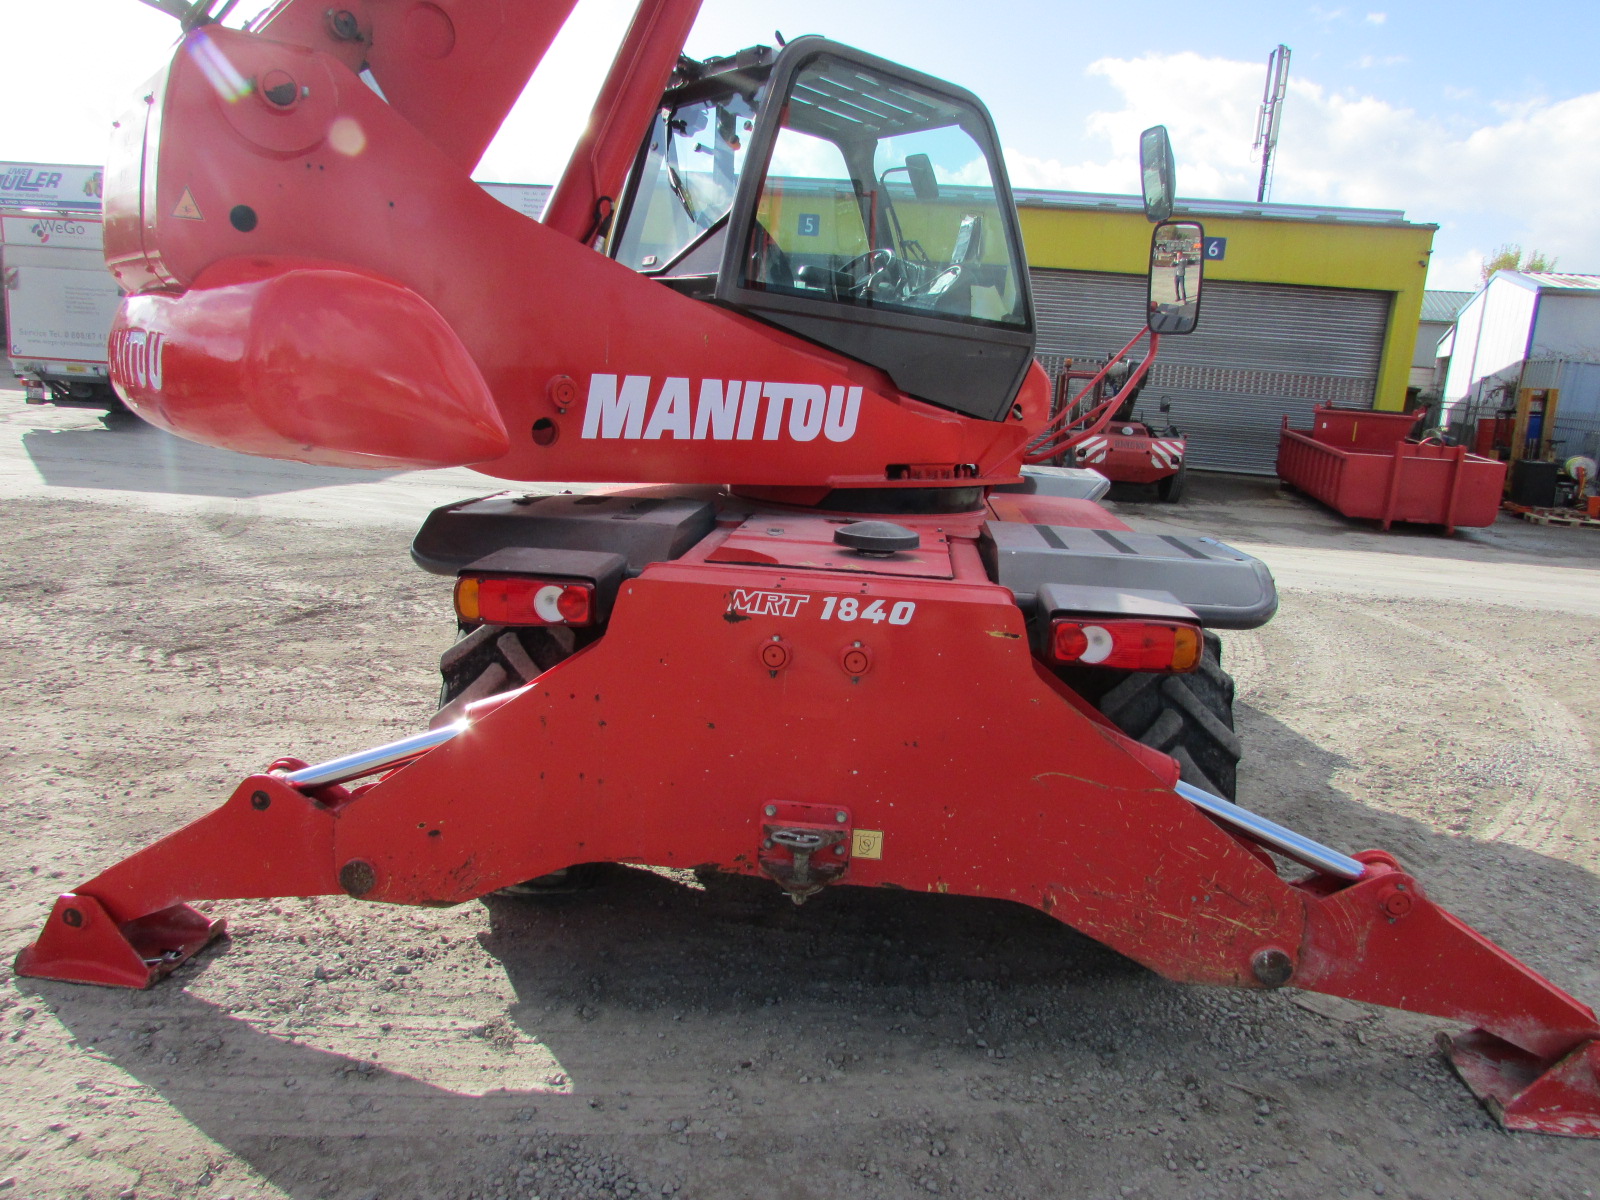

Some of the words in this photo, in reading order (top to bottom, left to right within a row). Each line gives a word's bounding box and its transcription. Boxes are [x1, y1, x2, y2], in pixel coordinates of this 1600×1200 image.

[40, 219, 85, 235] WeGo
[804, 217, 813, 233] 5
[1208, 241, 1218, 257] 6
[581, 373, 863, 442] MANITOU
[727, 589, 810, 617] MRT
[820, 596, 916, 625] 1840
